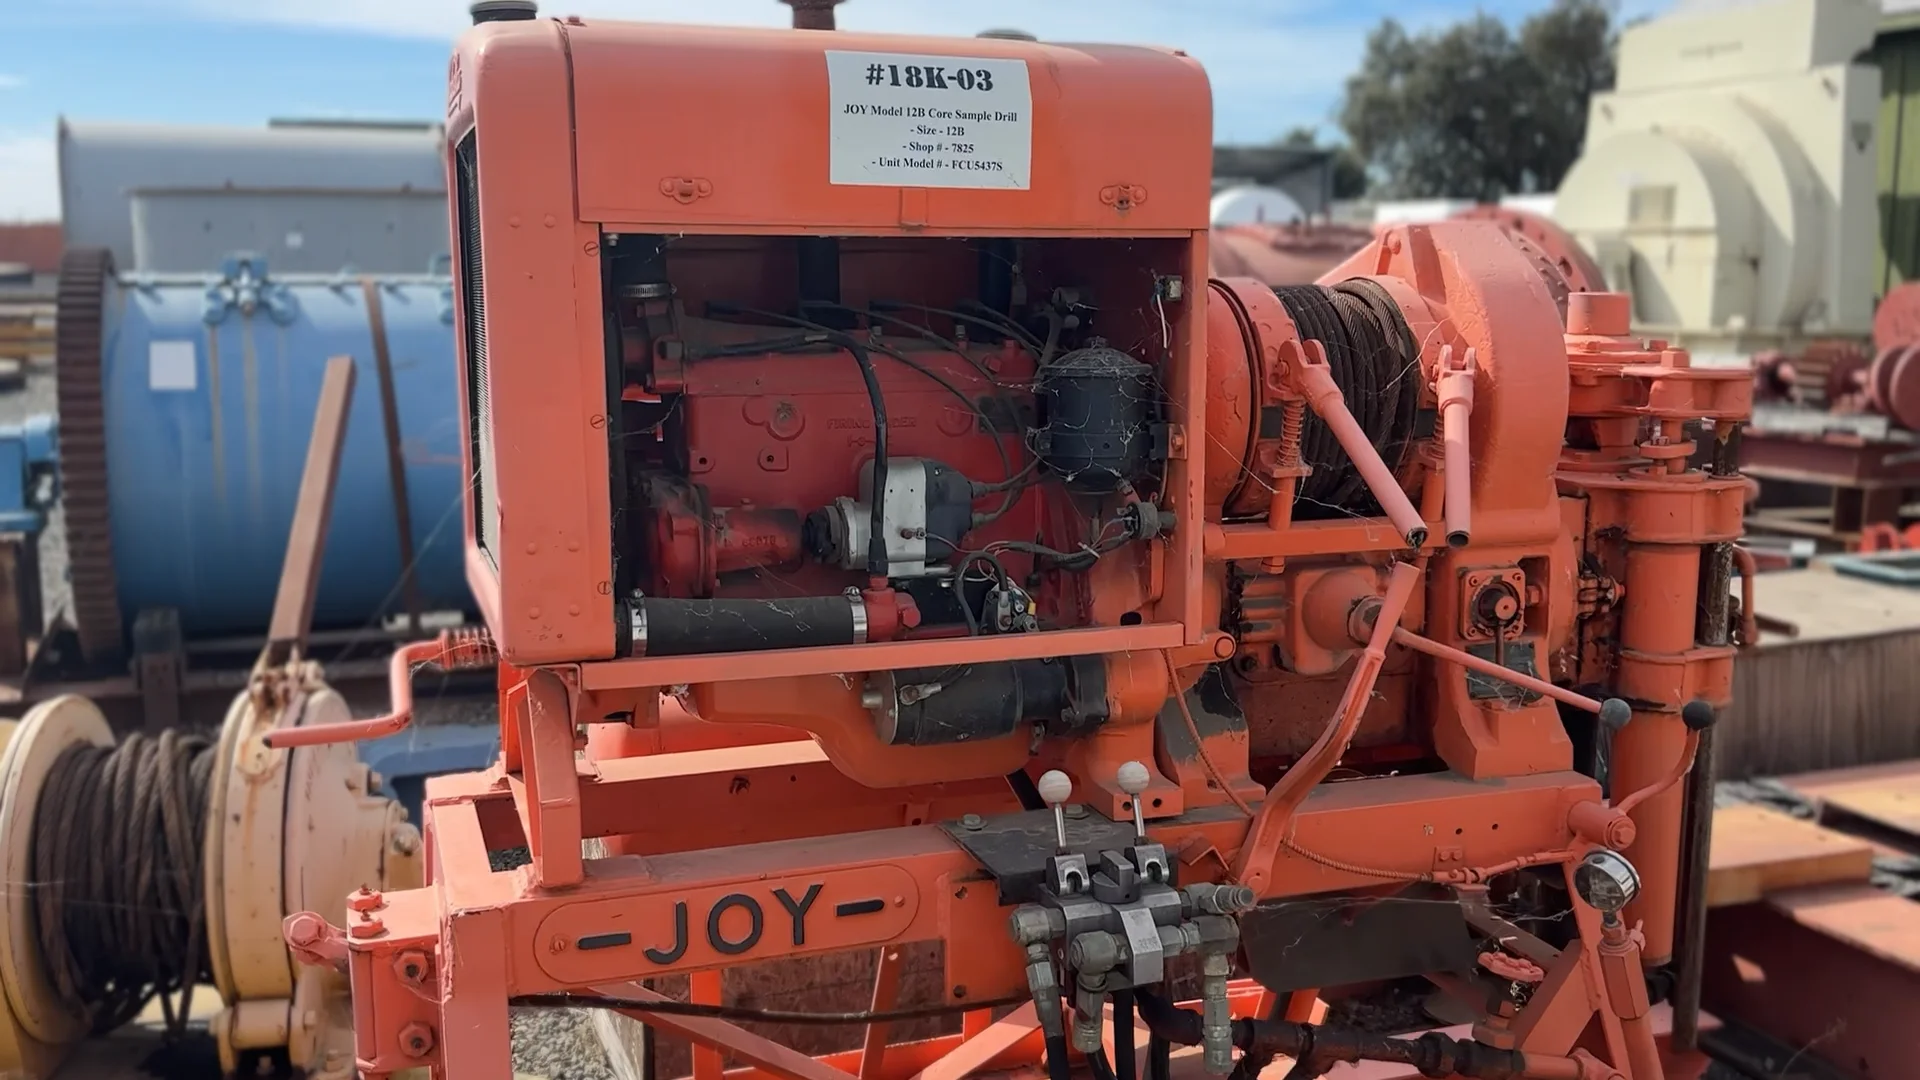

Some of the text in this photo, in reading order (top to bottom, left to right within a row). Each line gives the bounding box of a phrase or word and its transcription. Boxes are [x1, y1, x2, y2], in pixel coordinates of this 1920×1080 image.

[865, 63, 994, 92] #18K-03
[843, 104, 1018, 123] JOY Model 12B Core Sample Drill
[916, 125, 937, 136] Size
[946, 126, 965, 137] 12B
[909, 141, 934, 154] Shop
[936, 143, 943, 153] #
[951, 143, 974, 154] 7825
[879, 156, 901, 168] Unit
[903, 158, 935, 169] Model
[936, 159, 942, 169] #
[951, 159, 1003, 172] FCU5437S
